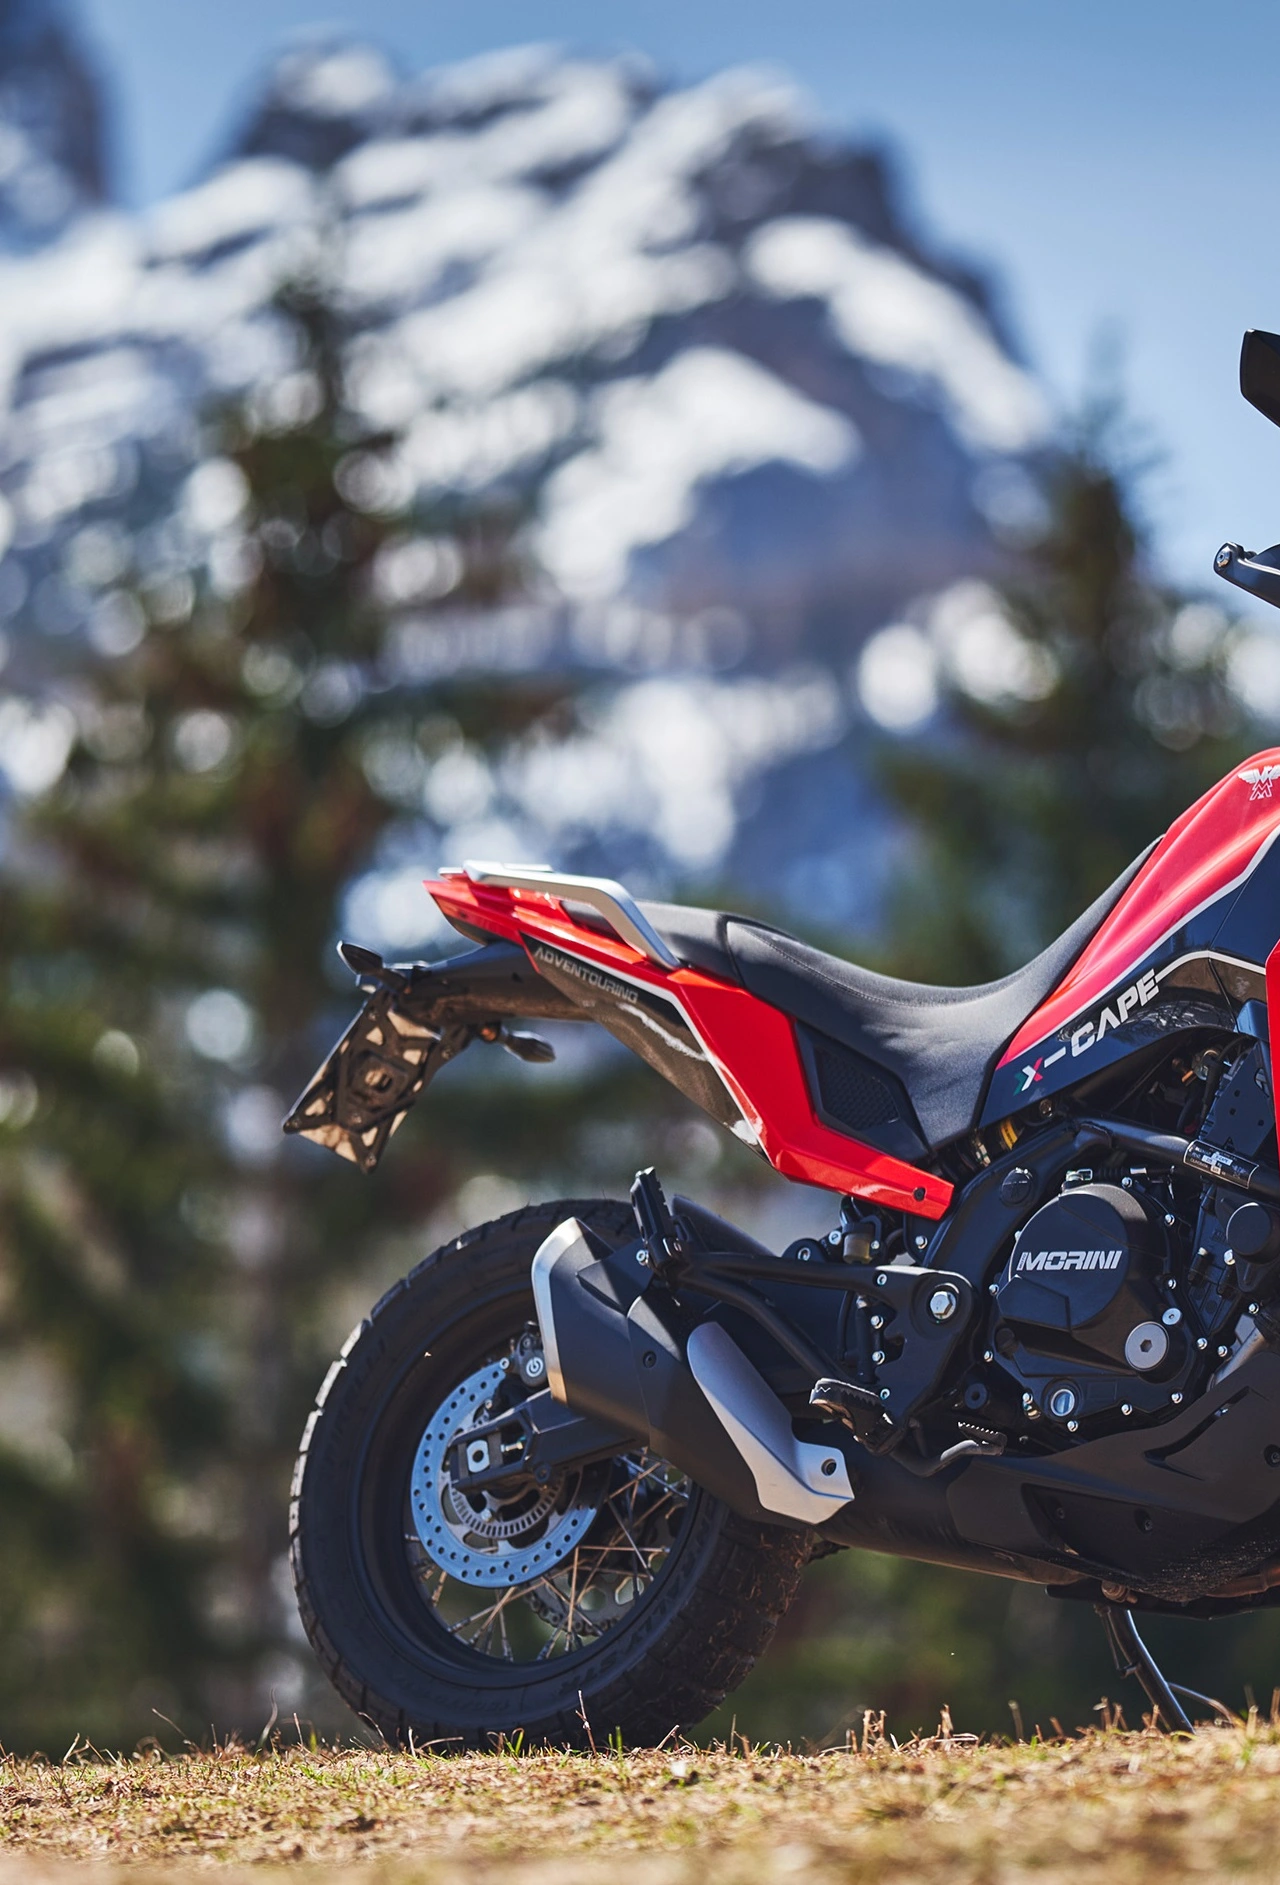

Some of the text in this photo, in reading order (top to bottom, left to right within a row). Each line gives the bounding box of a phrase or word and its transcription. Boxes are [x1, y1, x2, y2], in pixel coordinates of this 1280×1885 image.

[533, 946, 639, 1004] ADVENTOURING
[1013, 968, 1160, 1096] X-CAPE
[1025, 1250, 1123, 1271] MORINI
